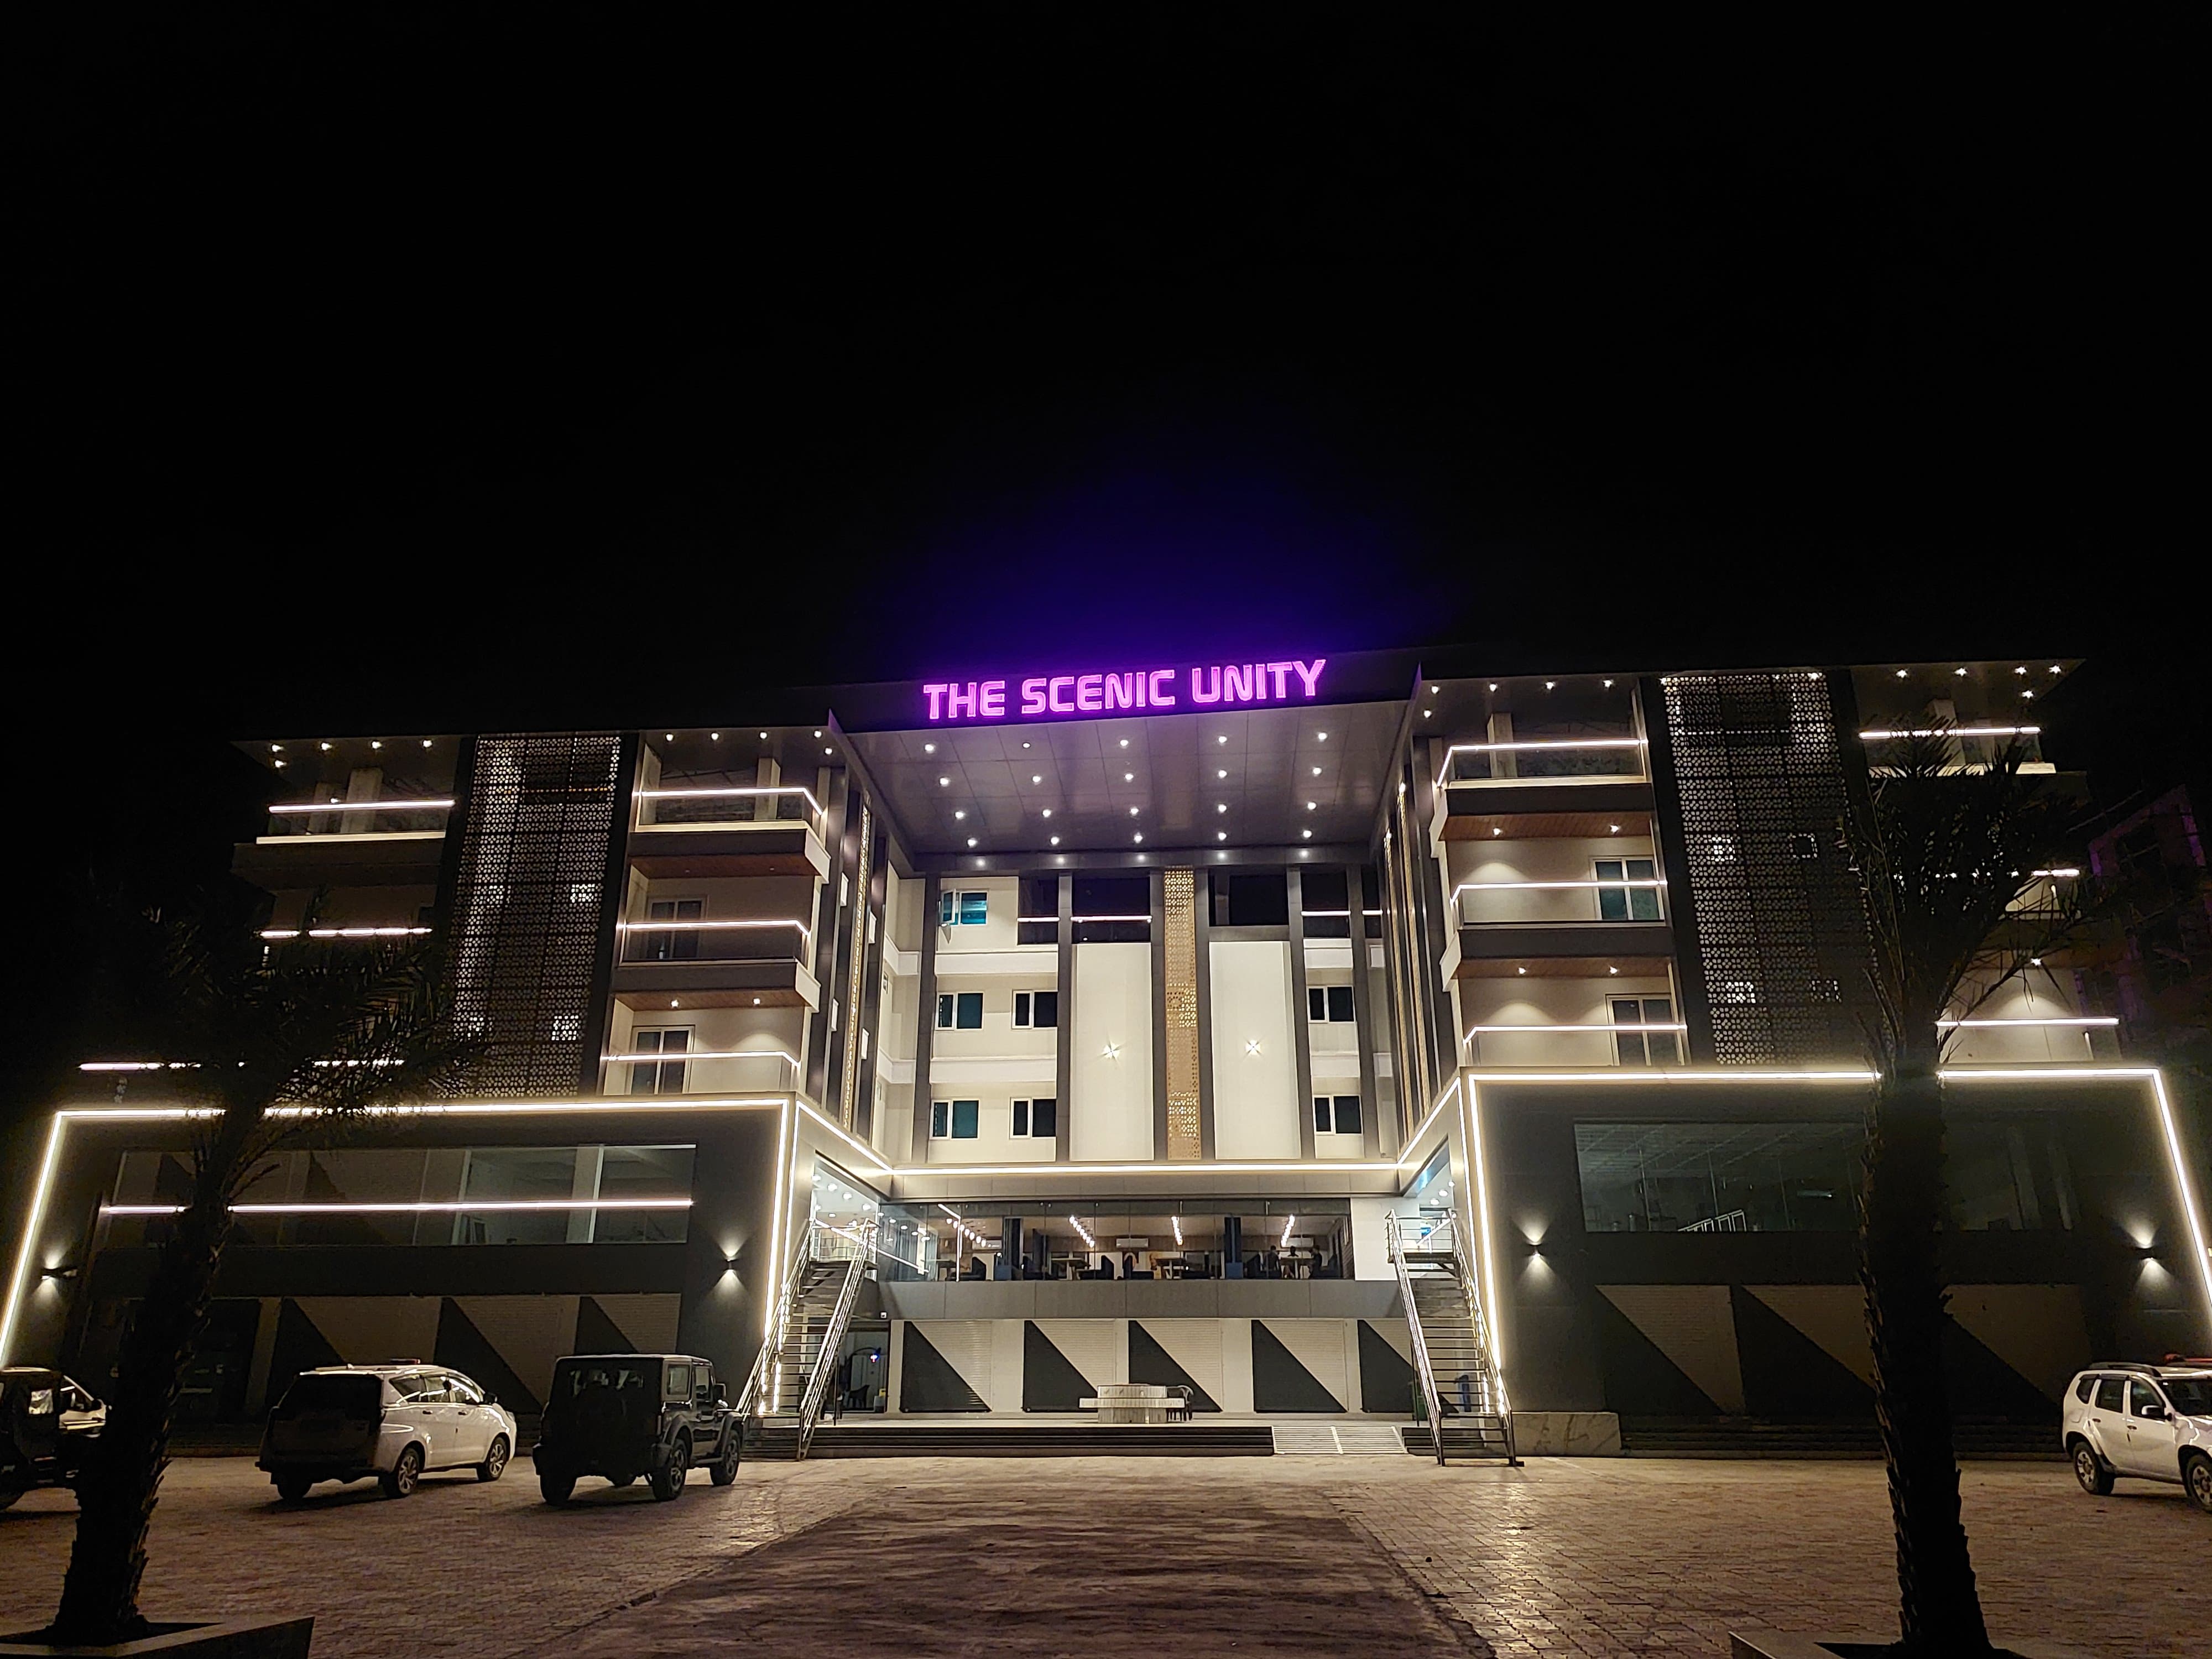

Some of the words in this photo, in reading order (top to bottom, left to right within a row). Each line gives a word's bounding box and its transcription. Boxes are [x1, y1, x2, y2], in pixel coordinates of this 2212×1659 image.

[923, 680, 1005, 719] THE
[1021, 669, 1176, 714] SCENIC
[1192, 659, 1326, 703] UNITY
